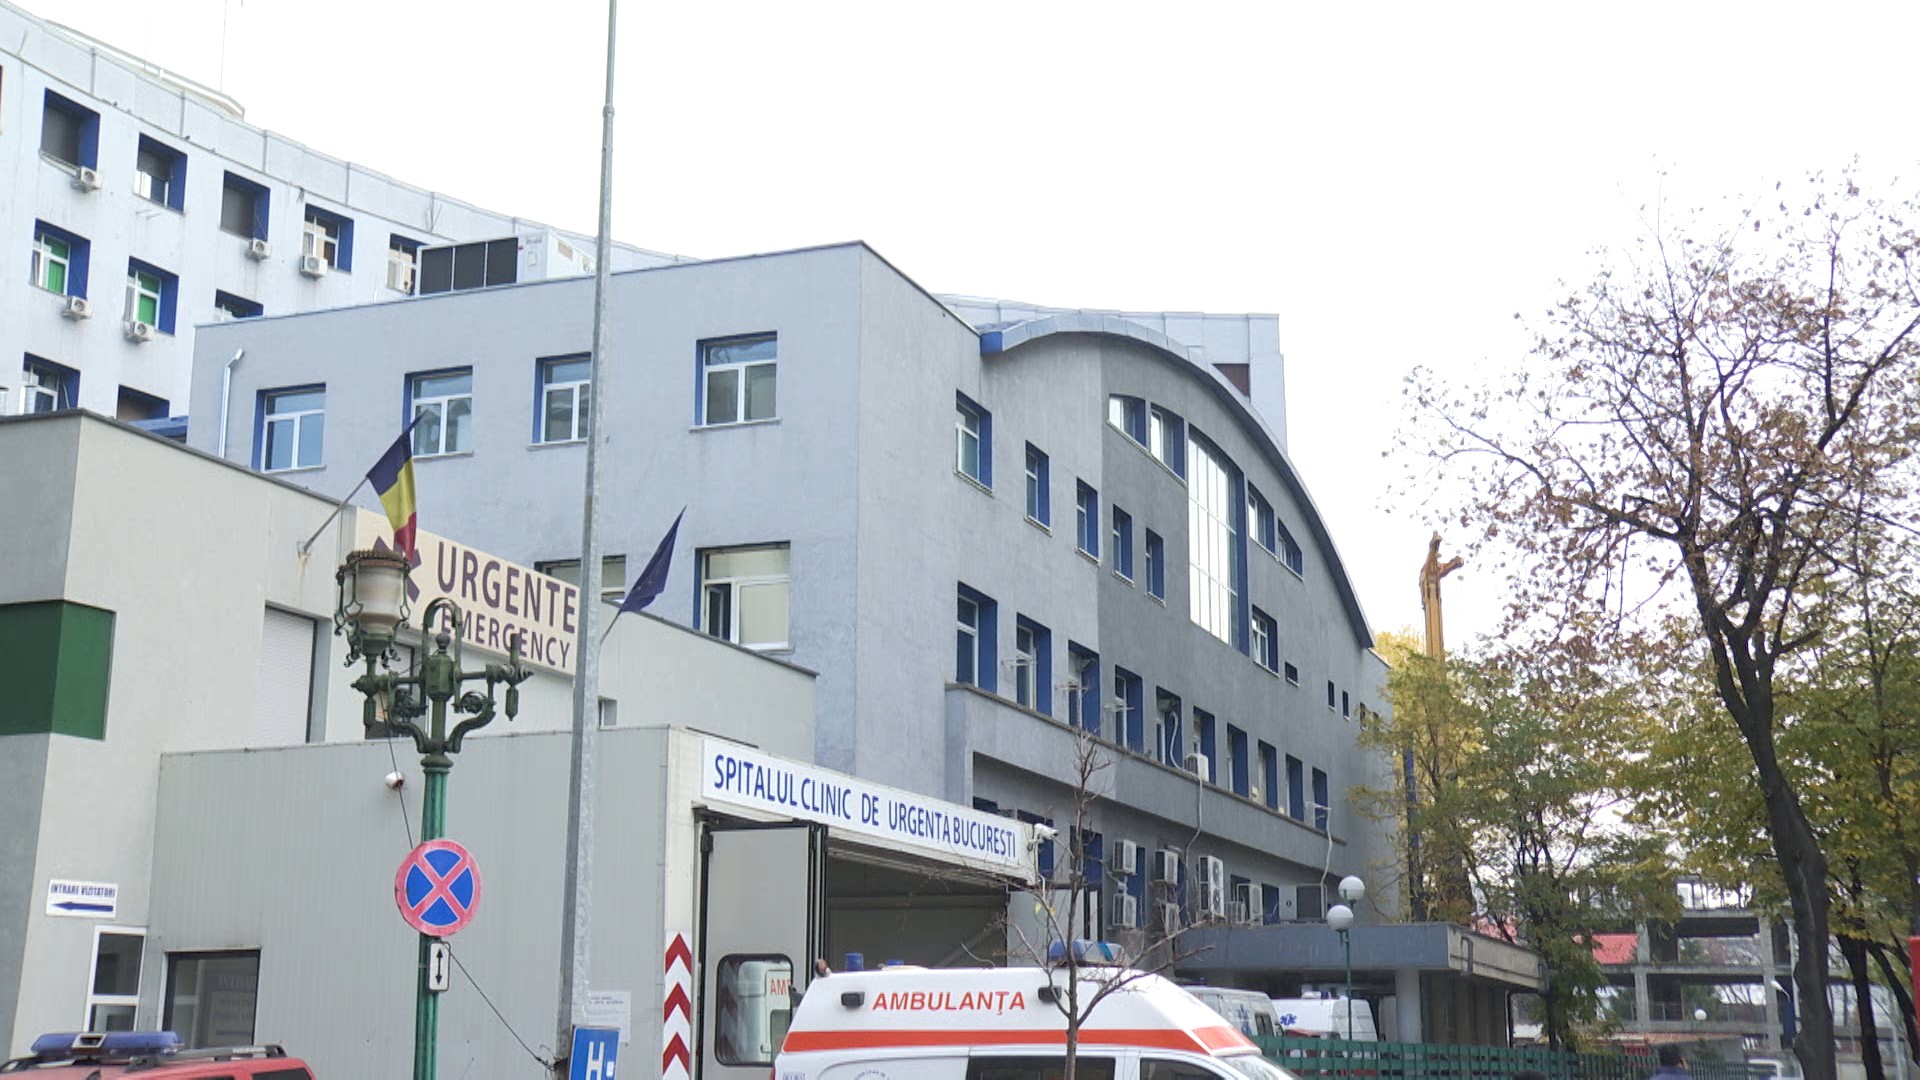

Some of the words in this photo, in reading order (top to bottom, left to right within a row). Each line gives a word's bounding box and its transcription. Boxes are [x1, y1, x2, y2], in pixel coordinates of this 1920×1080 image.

[437, 541, 577, 634] URGENTE
[714, 754, 798, 807] SPITALUL
[801, 777, 851, 820] CLINIC
[861, 793, 880, 826] DE
[584, 1041, 605, 1080] H
